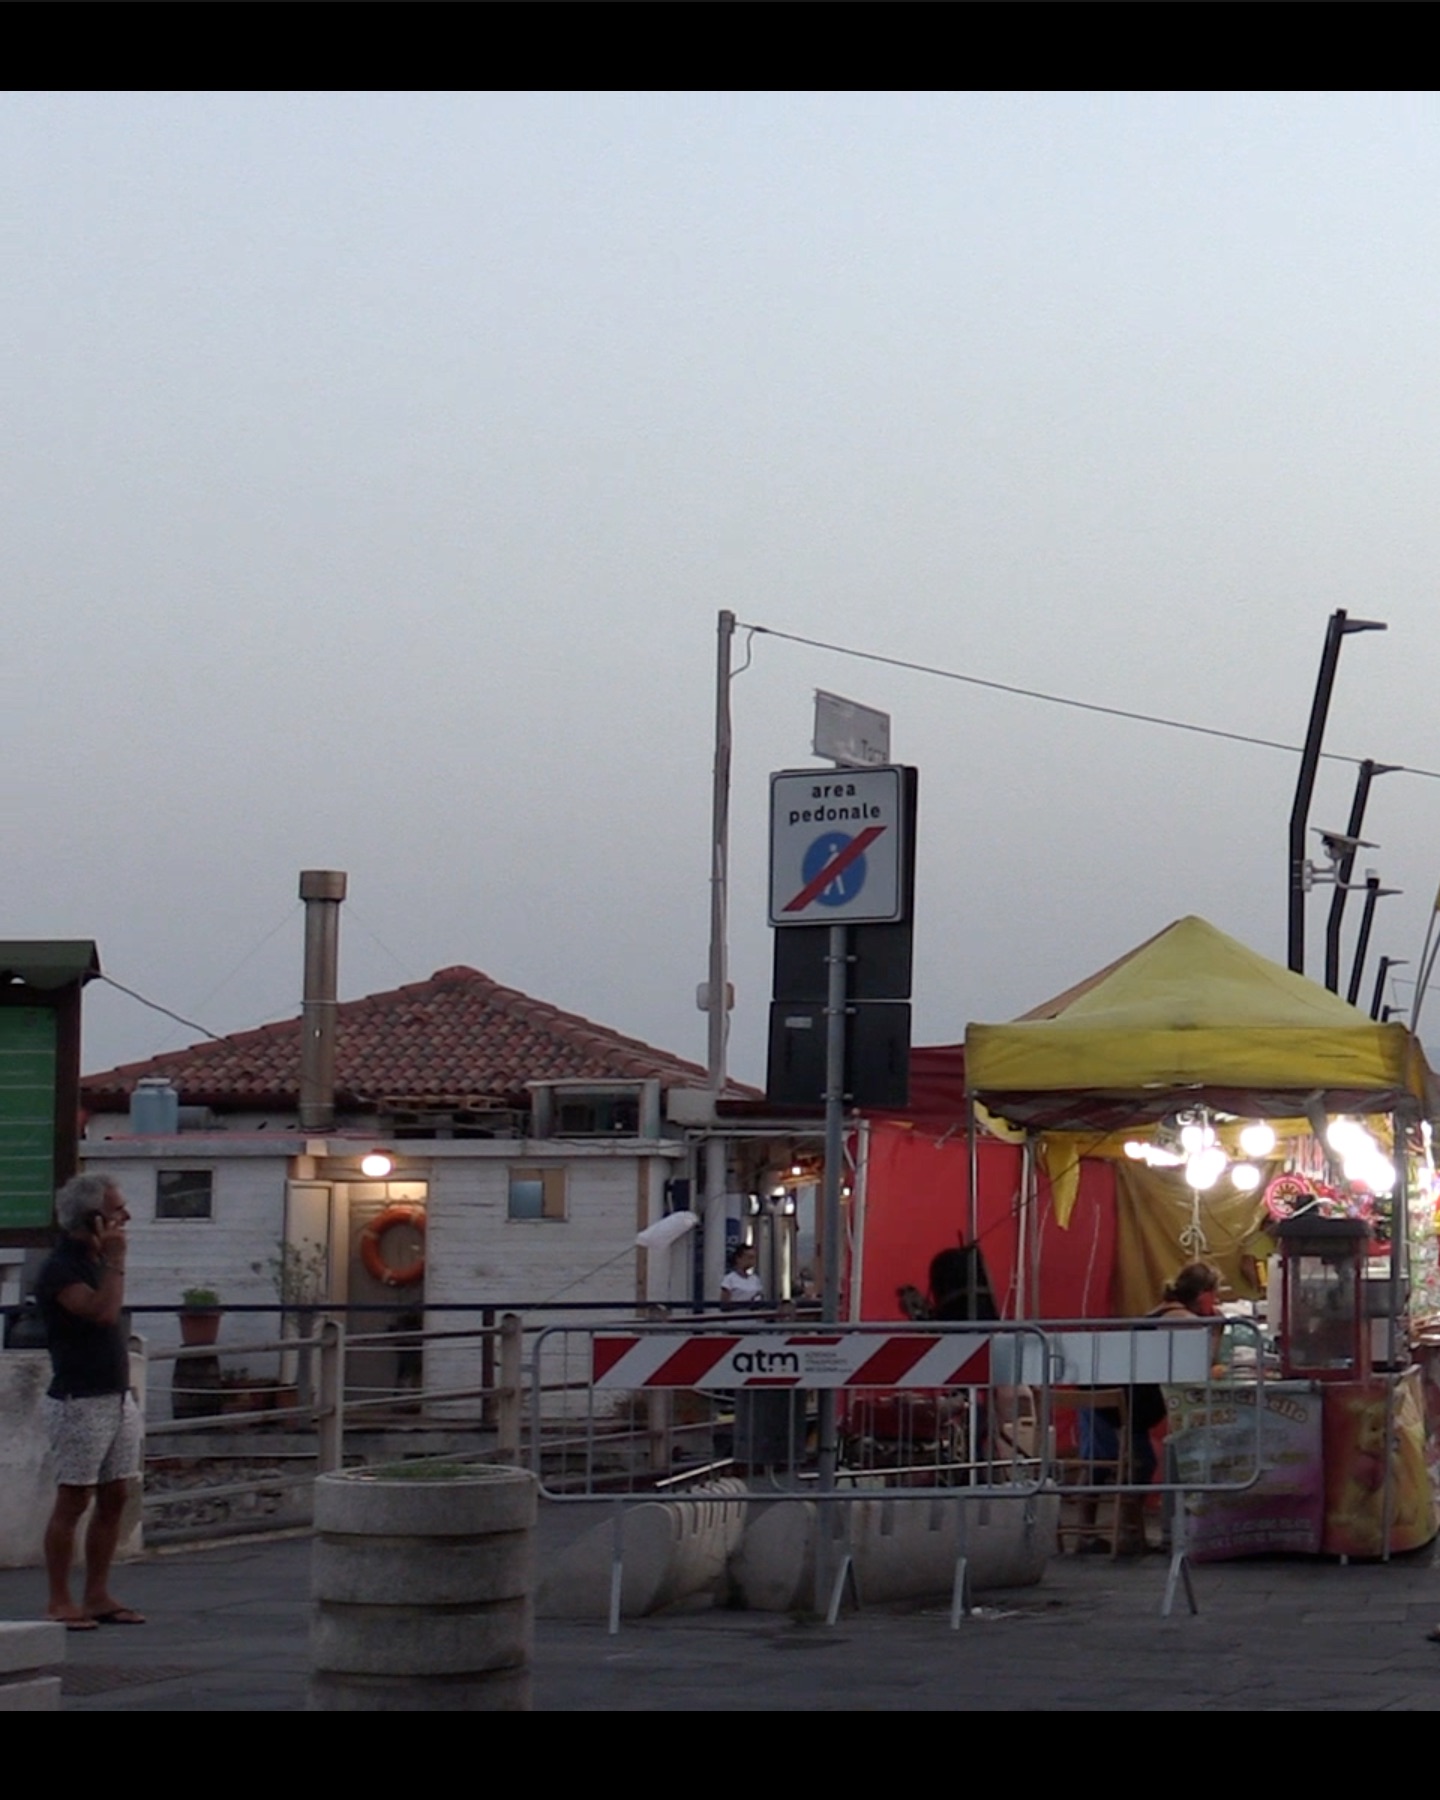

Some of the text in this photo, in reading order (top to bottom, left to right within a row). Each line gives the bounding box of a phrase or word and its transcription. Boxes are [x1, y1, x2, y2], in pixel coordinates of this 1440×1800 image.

[811, 783, 857, 799] area
[788, 803, 881, 825] pedonale
[732, 1349, 799, 1373] atm
